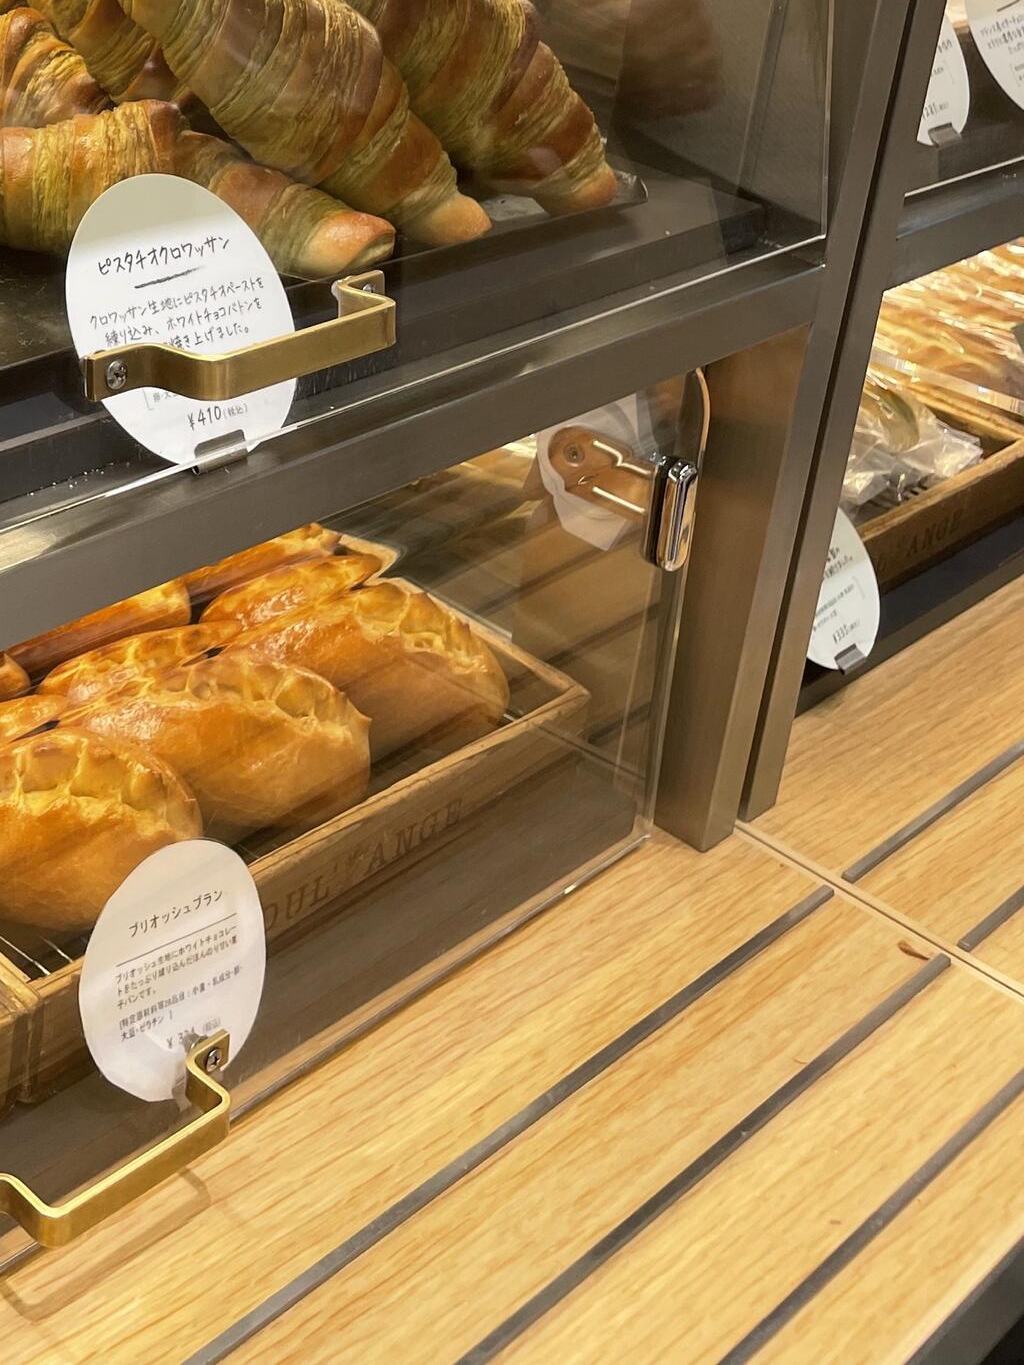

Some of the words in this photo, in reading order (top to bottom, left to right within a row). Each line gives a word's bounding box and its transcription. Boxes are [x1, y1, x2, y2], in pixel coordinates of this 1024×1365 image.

[97, 236, 230, 277] ピスタチオクロワッサン
[128, 889, 223, 938] ブリオッシュブラン
